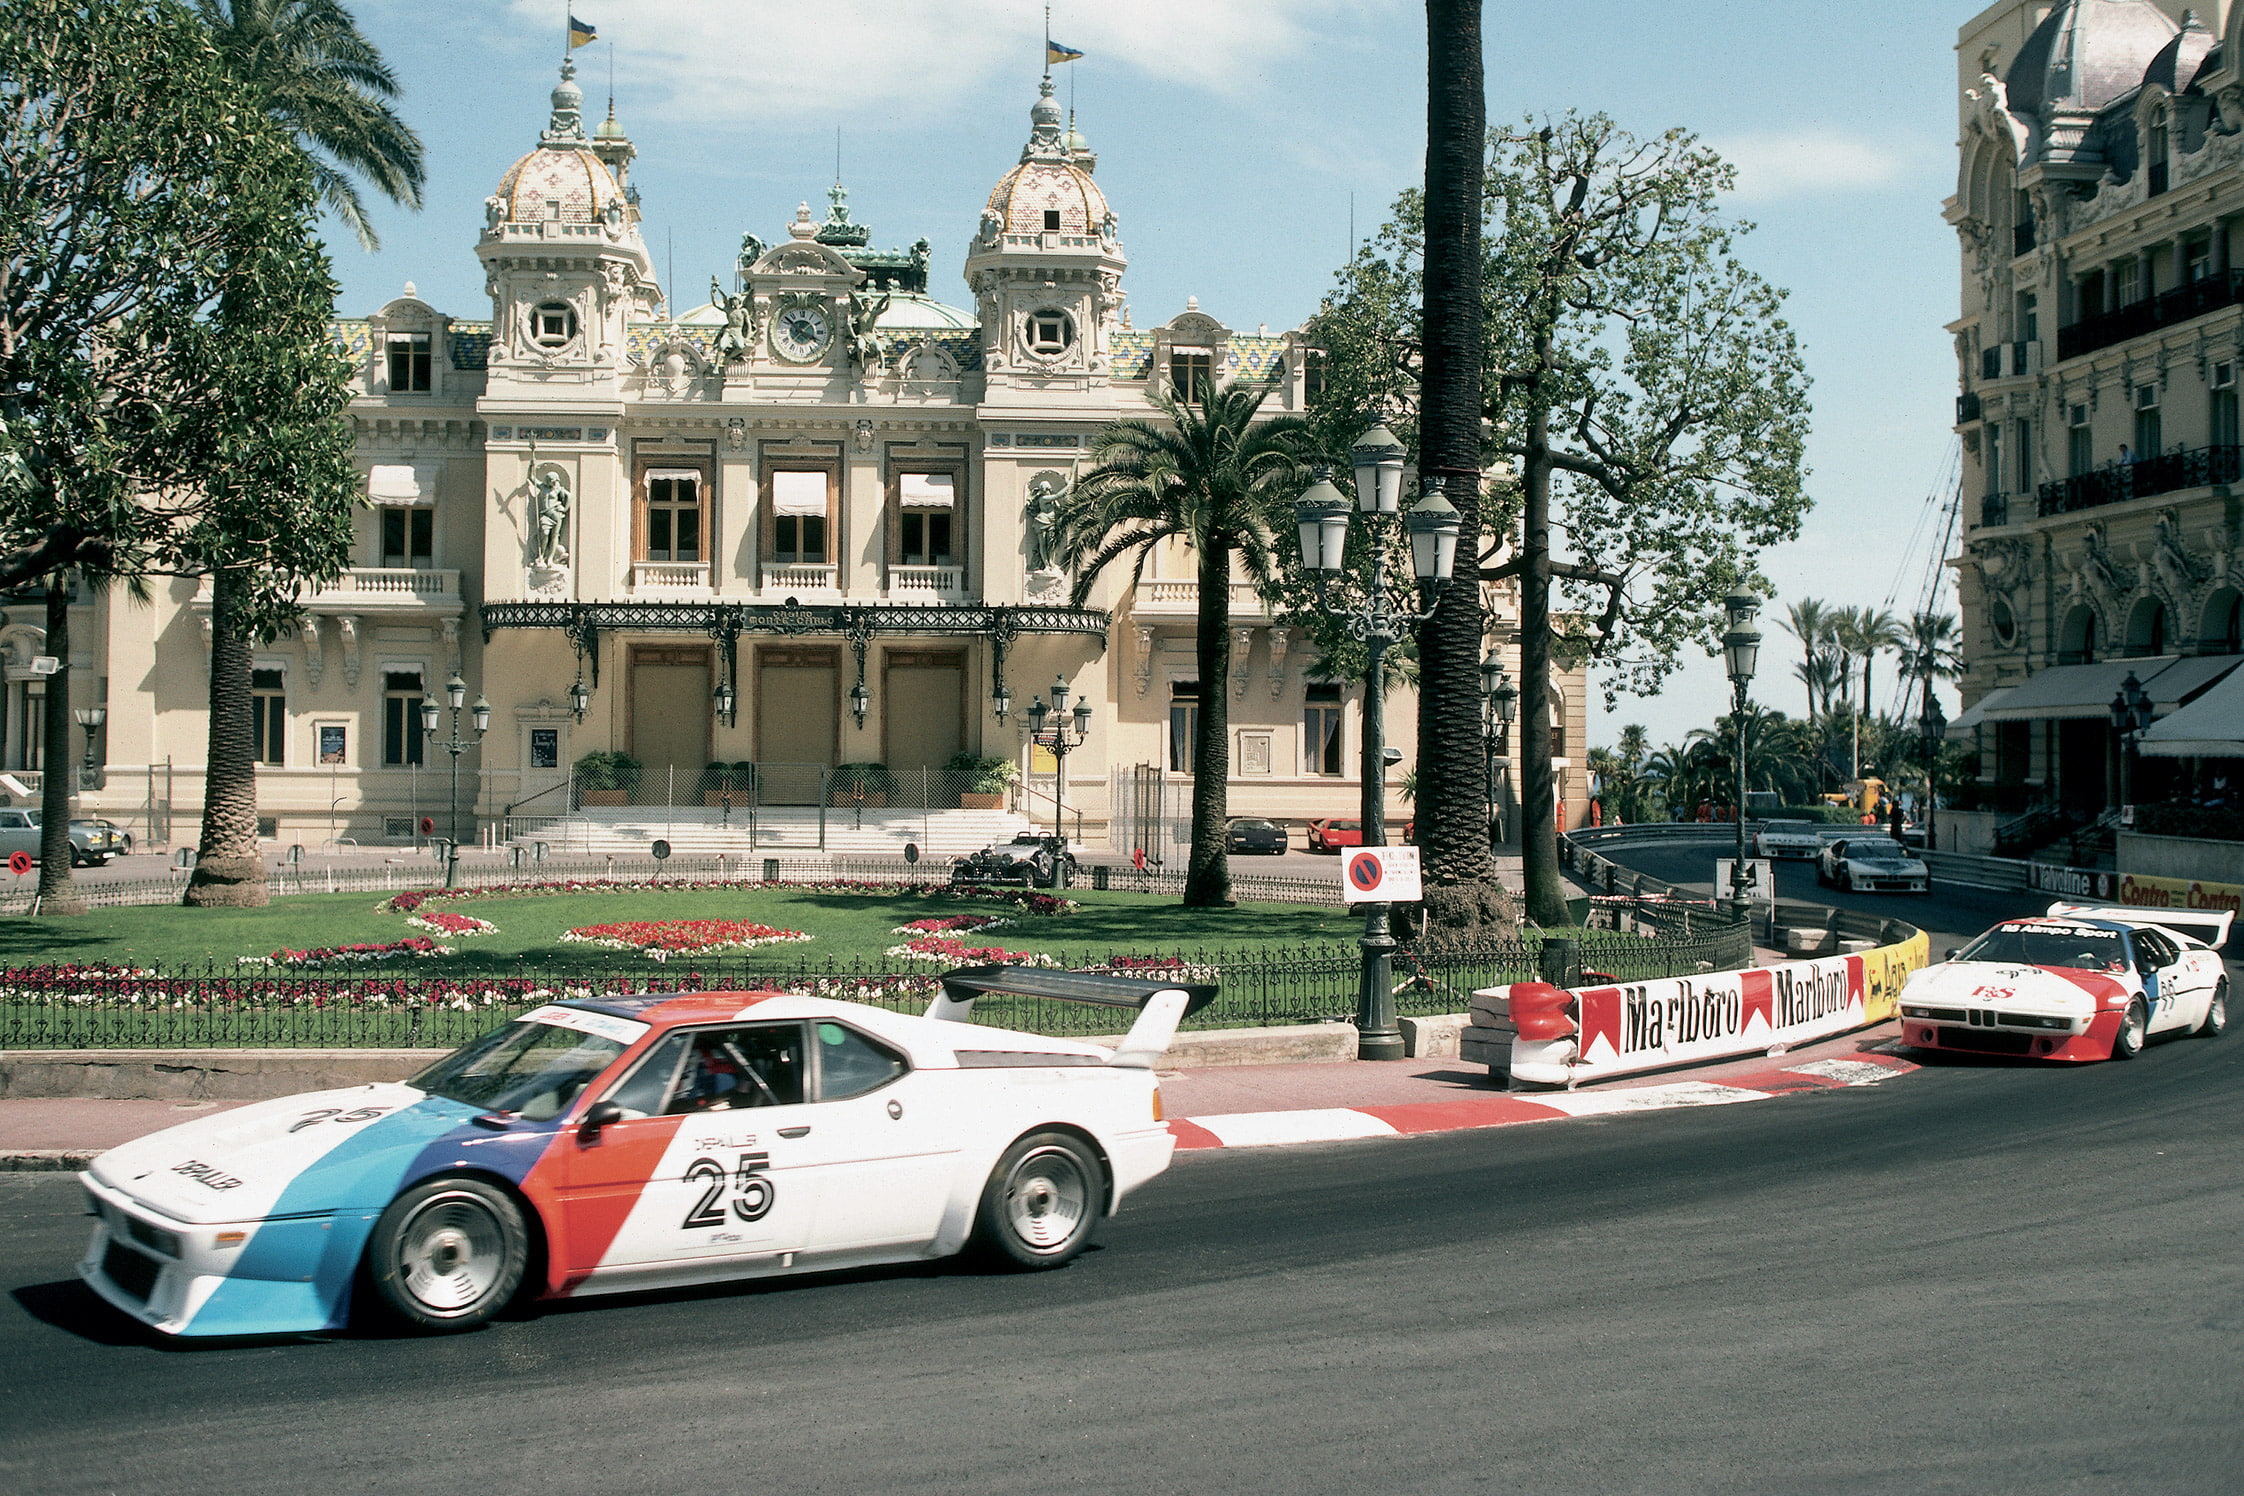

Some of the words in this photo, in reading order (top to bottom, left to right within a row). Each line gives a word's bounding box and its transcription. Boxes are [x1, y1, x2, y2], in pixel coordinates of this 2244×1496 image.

[750, 617, 834, 625] MONTE-CARLO
[2039, 865, 2091, 895] Valvoline
[2075, 927, 2118, 939] Sport
[1624, 980, 1739, 1053] Marlboro
[1776, 965, 1847, 1029] Marlboro
[288, 1106, 394, 1133] 25
[682, 1152, 775, 1229] 25
